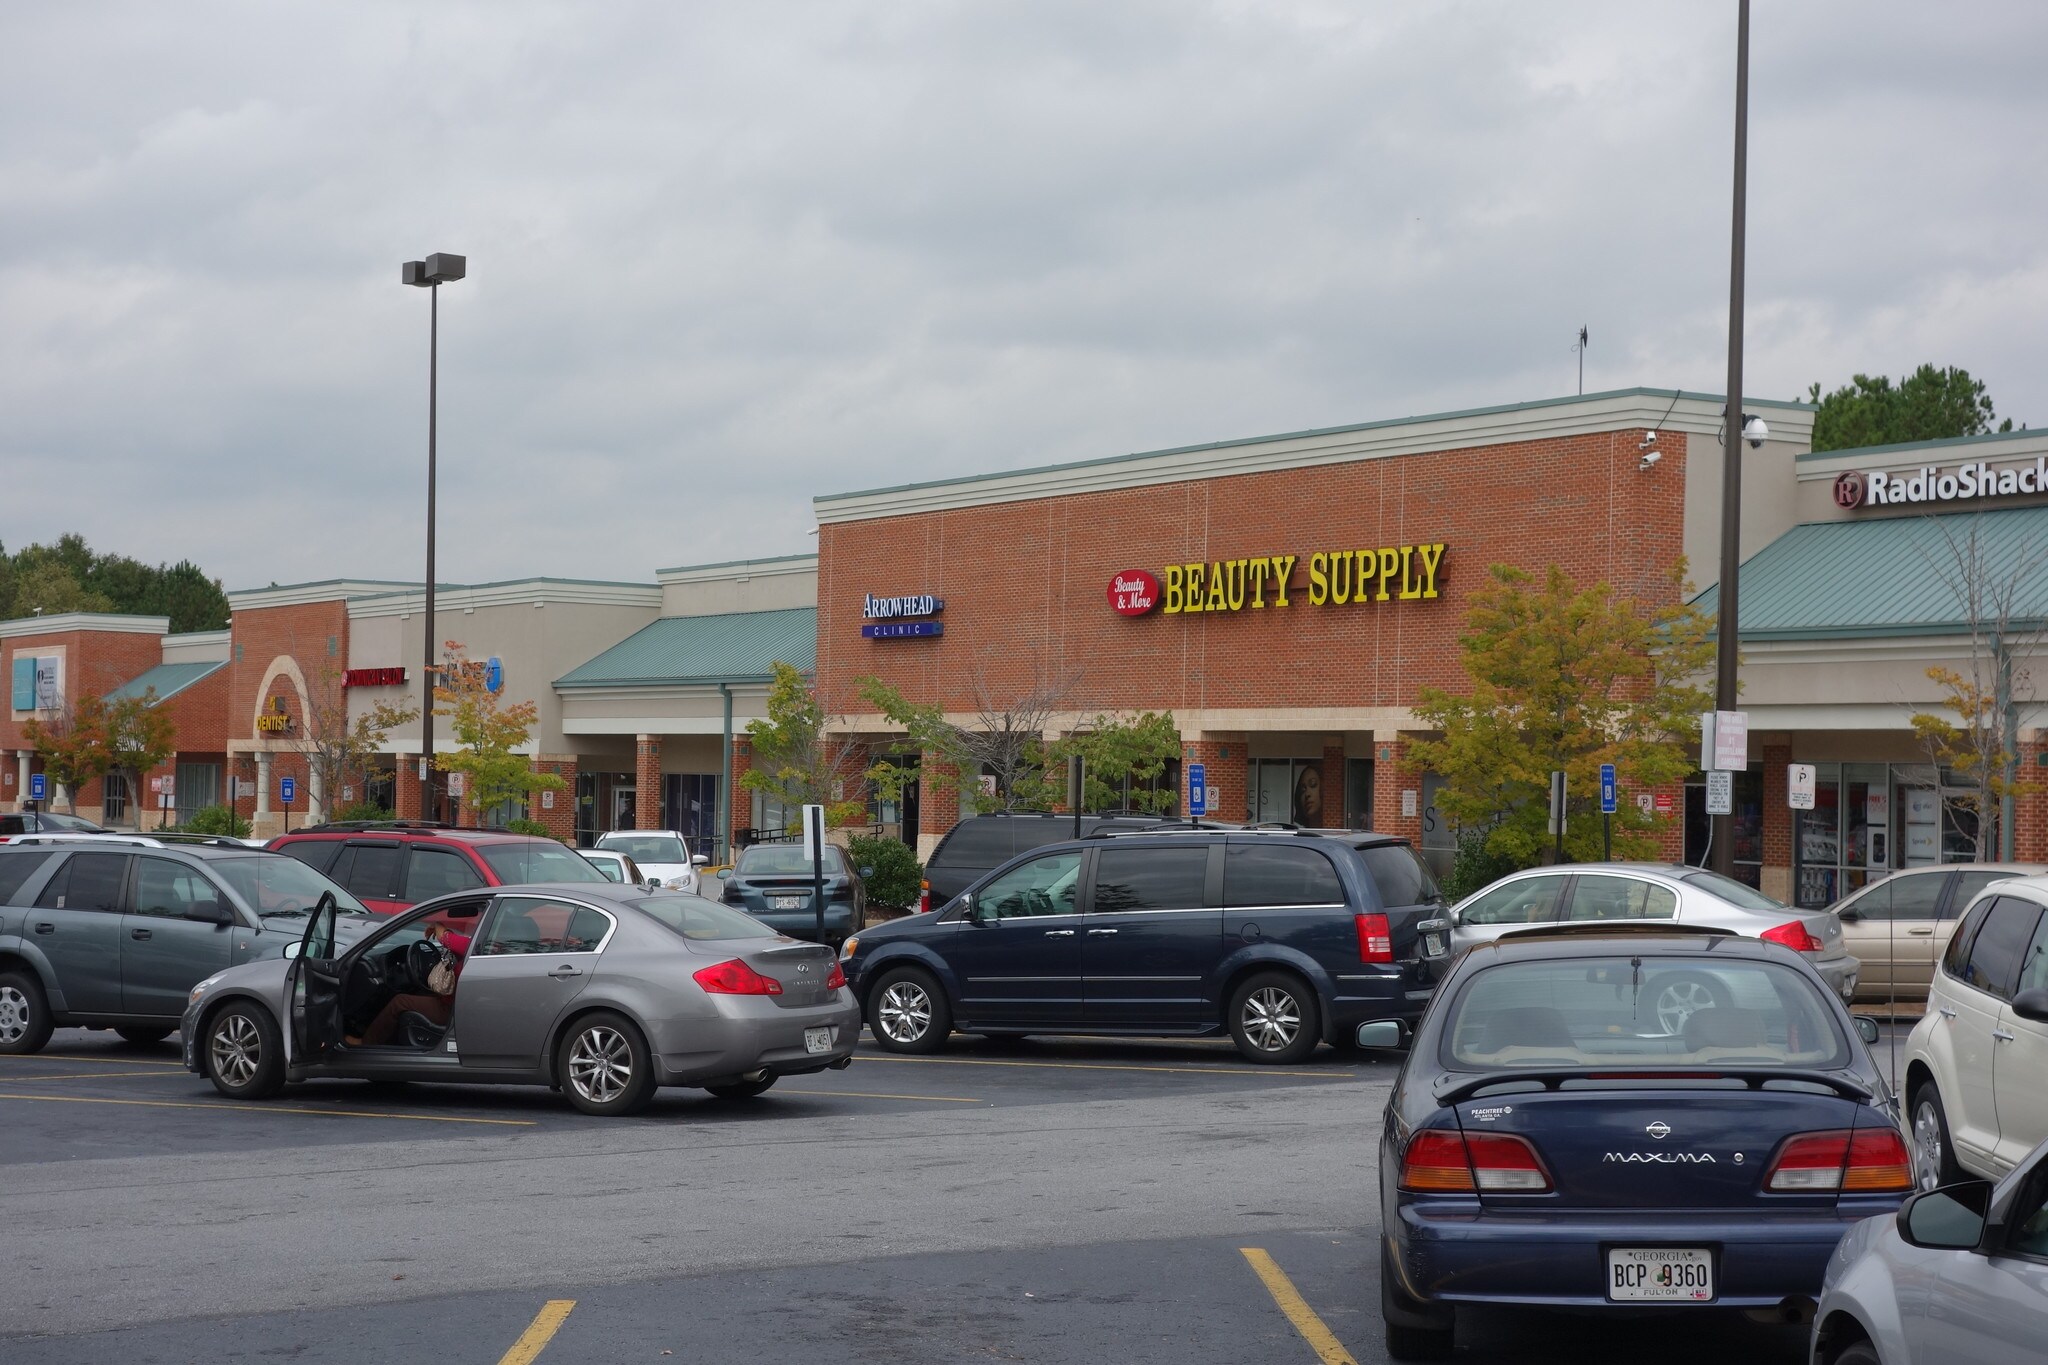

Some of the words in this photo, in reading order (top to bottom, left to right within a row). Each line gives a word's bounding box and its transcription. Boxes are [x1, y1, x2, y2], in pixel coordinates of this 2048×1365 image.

[1868, 457, 2048, 505] RadioShack
[1114, 576, 1146, 596] Beauty
[1163, 555, 1297, 614] BEAUTY
[1308, 543, 1446, 606] SUPPLY
[863, 593, 934, 618] ARROWHEAD
[1118, 595, 1126, 609] &
[1127, 594, 1152, 609] More
[874, 624, 920, 636] CLINIC
[256, 715, 288, 731] DENTIST
[1614, 1263, 1647, 1288] BCP
[1662, 1263, 1708, 1288] 9360
